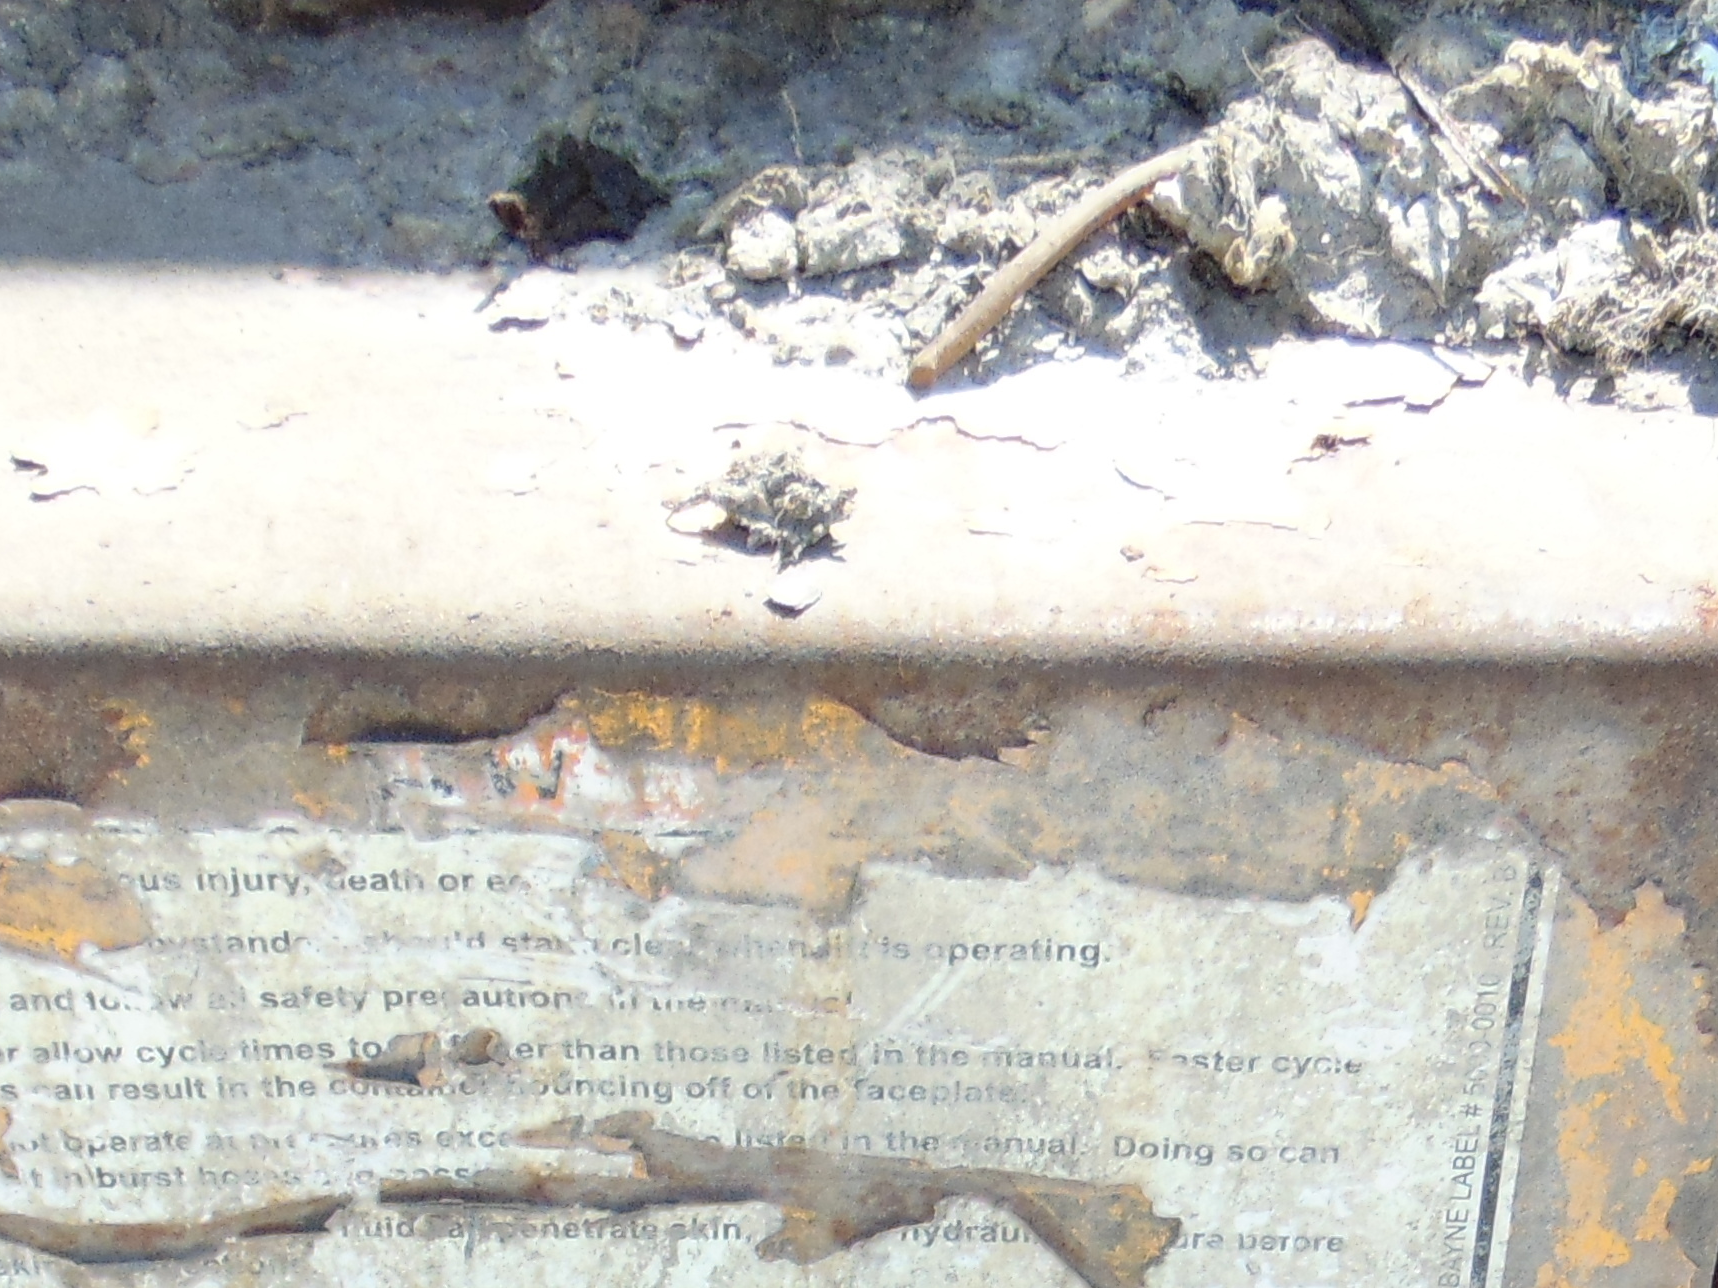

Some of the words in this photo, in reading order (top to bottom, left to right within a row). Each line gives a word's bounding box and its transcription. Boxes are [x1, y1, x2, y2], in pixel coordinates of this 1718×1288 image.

[196, 867, 310, 896] injury,
[438, 872, 474, 892] or
[925, 937, 1111, 968] operating.
[9, 988, 74, 1011] and
[259, 985, 367, 1011] safety
[33, 1041, 122, 1065] allow
[136, 1040, 229, 1068] cycle
[241, 1038, 336, 1062] times
[350, 1037, 383, 1060] to
[562, 1038, 640, 1062] than
[654, 1039, 749, 1064] those
[763, 1041, 857, 1066] listed
[873, 1043, 904, 1066] in
[915, 1045, 969, 1068] the
[981, 1046, 1123, 1071] manual.
[108, 1077, 206, 1101] result
[216, 1075, 247, 1099] in
[261, 1074, 317, 1098] the
[686, 1075, 732, 1100] off
[785, 1076, 840, 1101] the
[886, 1131, 940, 1153] the
[1114, 1134, 1215, 1166] Doing
[1226, 1143, 1266, 1163] so
[1278, 1143, 1340, 1165] can
[1450, 1123, 1482, 1201] LABEL
[95, 1166, 185, 1188] burst
[1437, 1207, 1470, 1288] BAYNE
